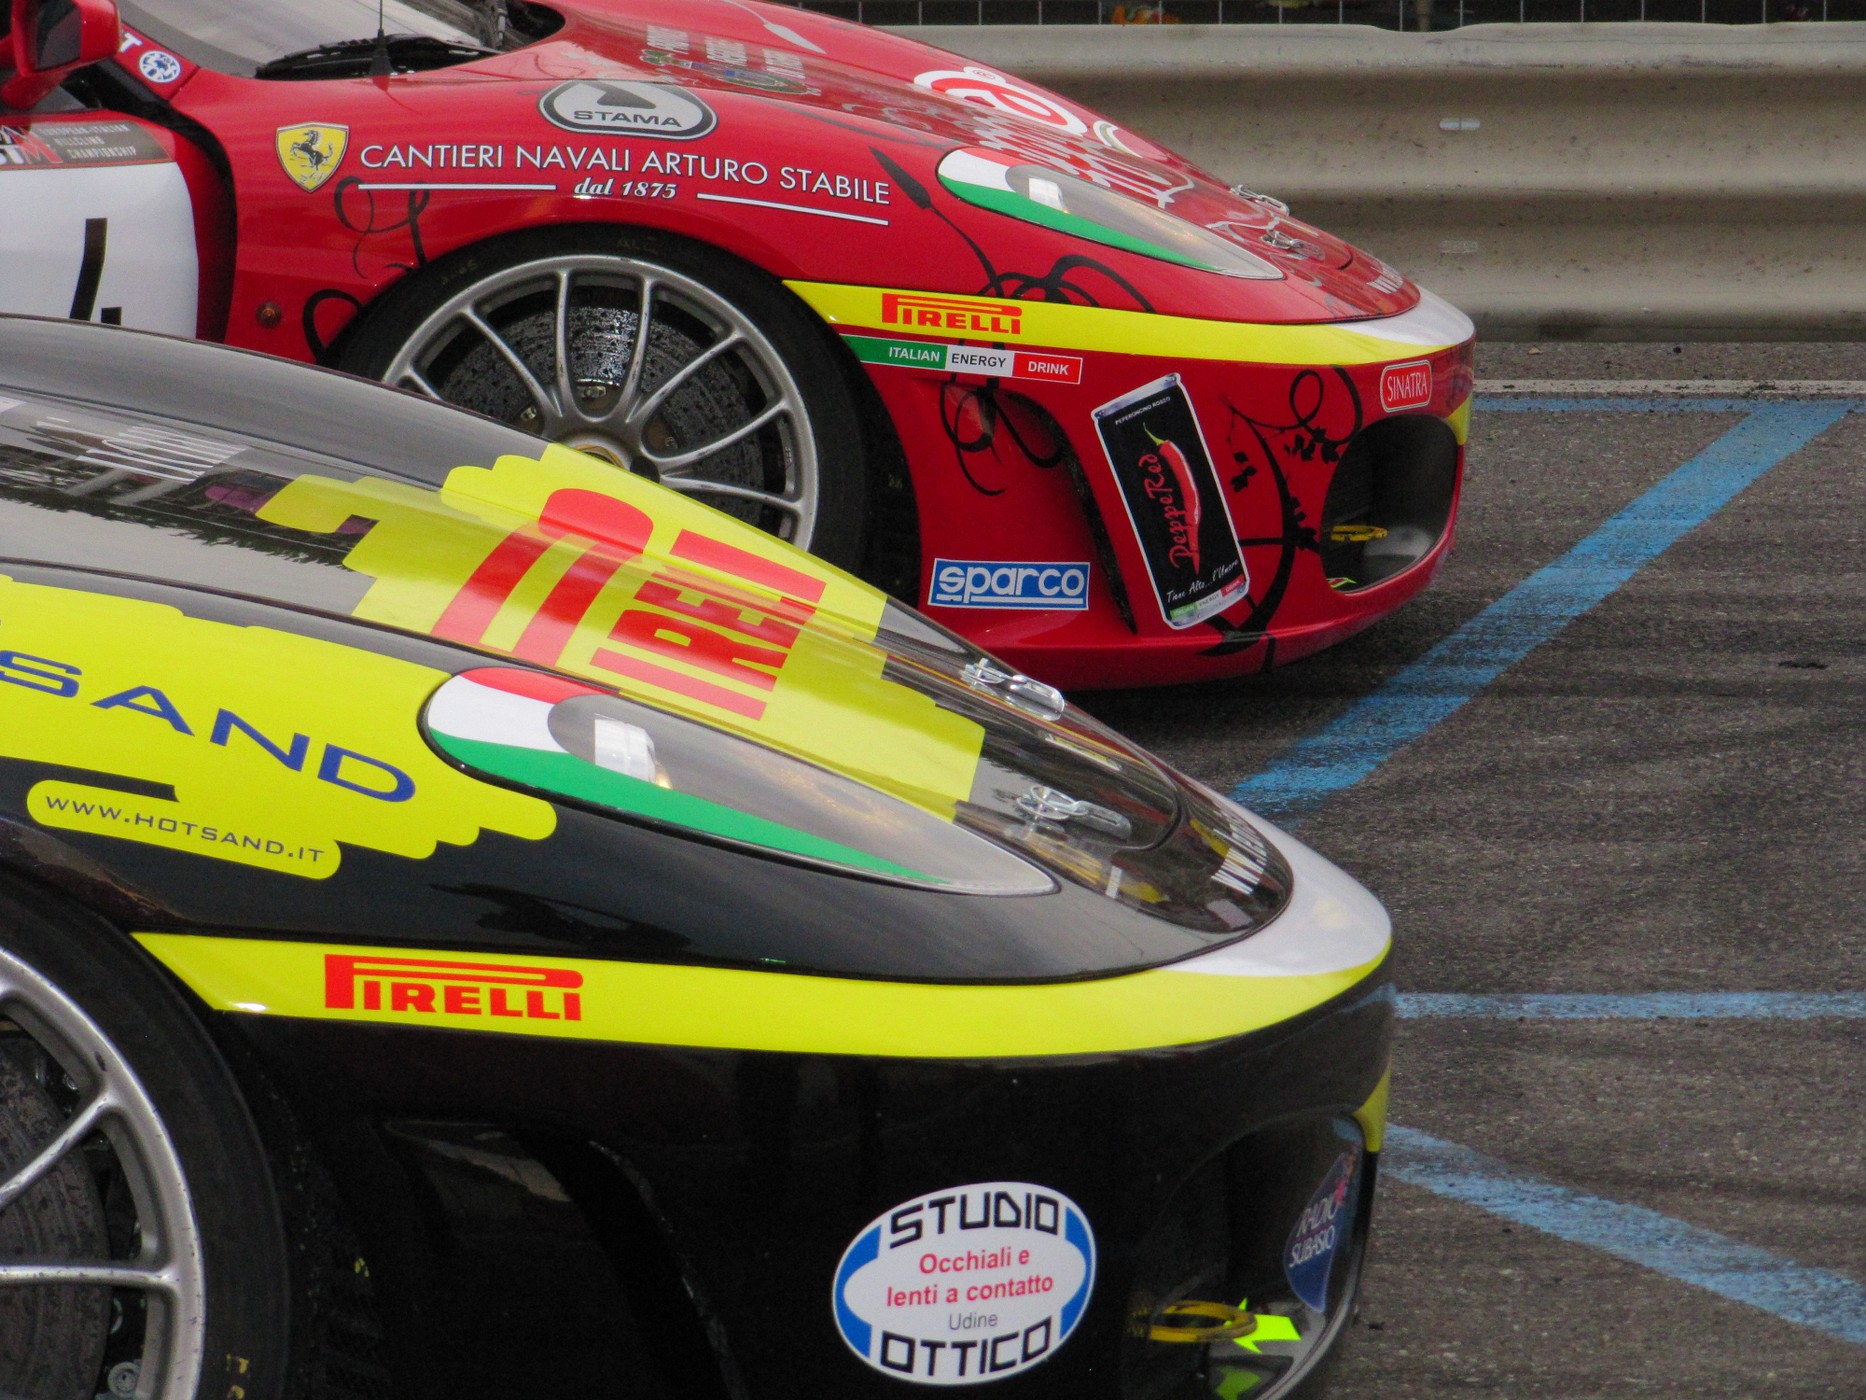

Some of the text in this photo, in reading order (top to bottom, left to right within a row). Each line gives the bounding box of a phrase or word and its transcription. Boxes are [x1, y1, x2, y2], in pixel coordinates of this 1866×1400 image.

[573, 109, 683, 128] STAMA
[66, 146, 137, 159] CHAMPIONSHIP
[359, 144, 890, 205] CANTIERI NAVALI ARTURO STABILE
[573, 177, 677, 200] dal 1875
[882, 293, 1023, 335] PIRELLI
[889, 346, 1069, 375] ITALIAN ENERGY DRINK
[1387, 372, 1428, 402] SINATRA
[938, 566, 1085, 604] sparco
[45, 795, 325, 863] WWW.HOTSAND.IT
[324, 953, 584, 1021] PIRELLI
[890, 1191, 1060, 1250] STUDIO
[919, 1246, 1030, 1274] Occhiali e
[886, 1274, 1054, 1307] lenti a contatto
[949, 1313, 998, 1331] Udine
[880, 1315, 1052, 1377] OTTICO
